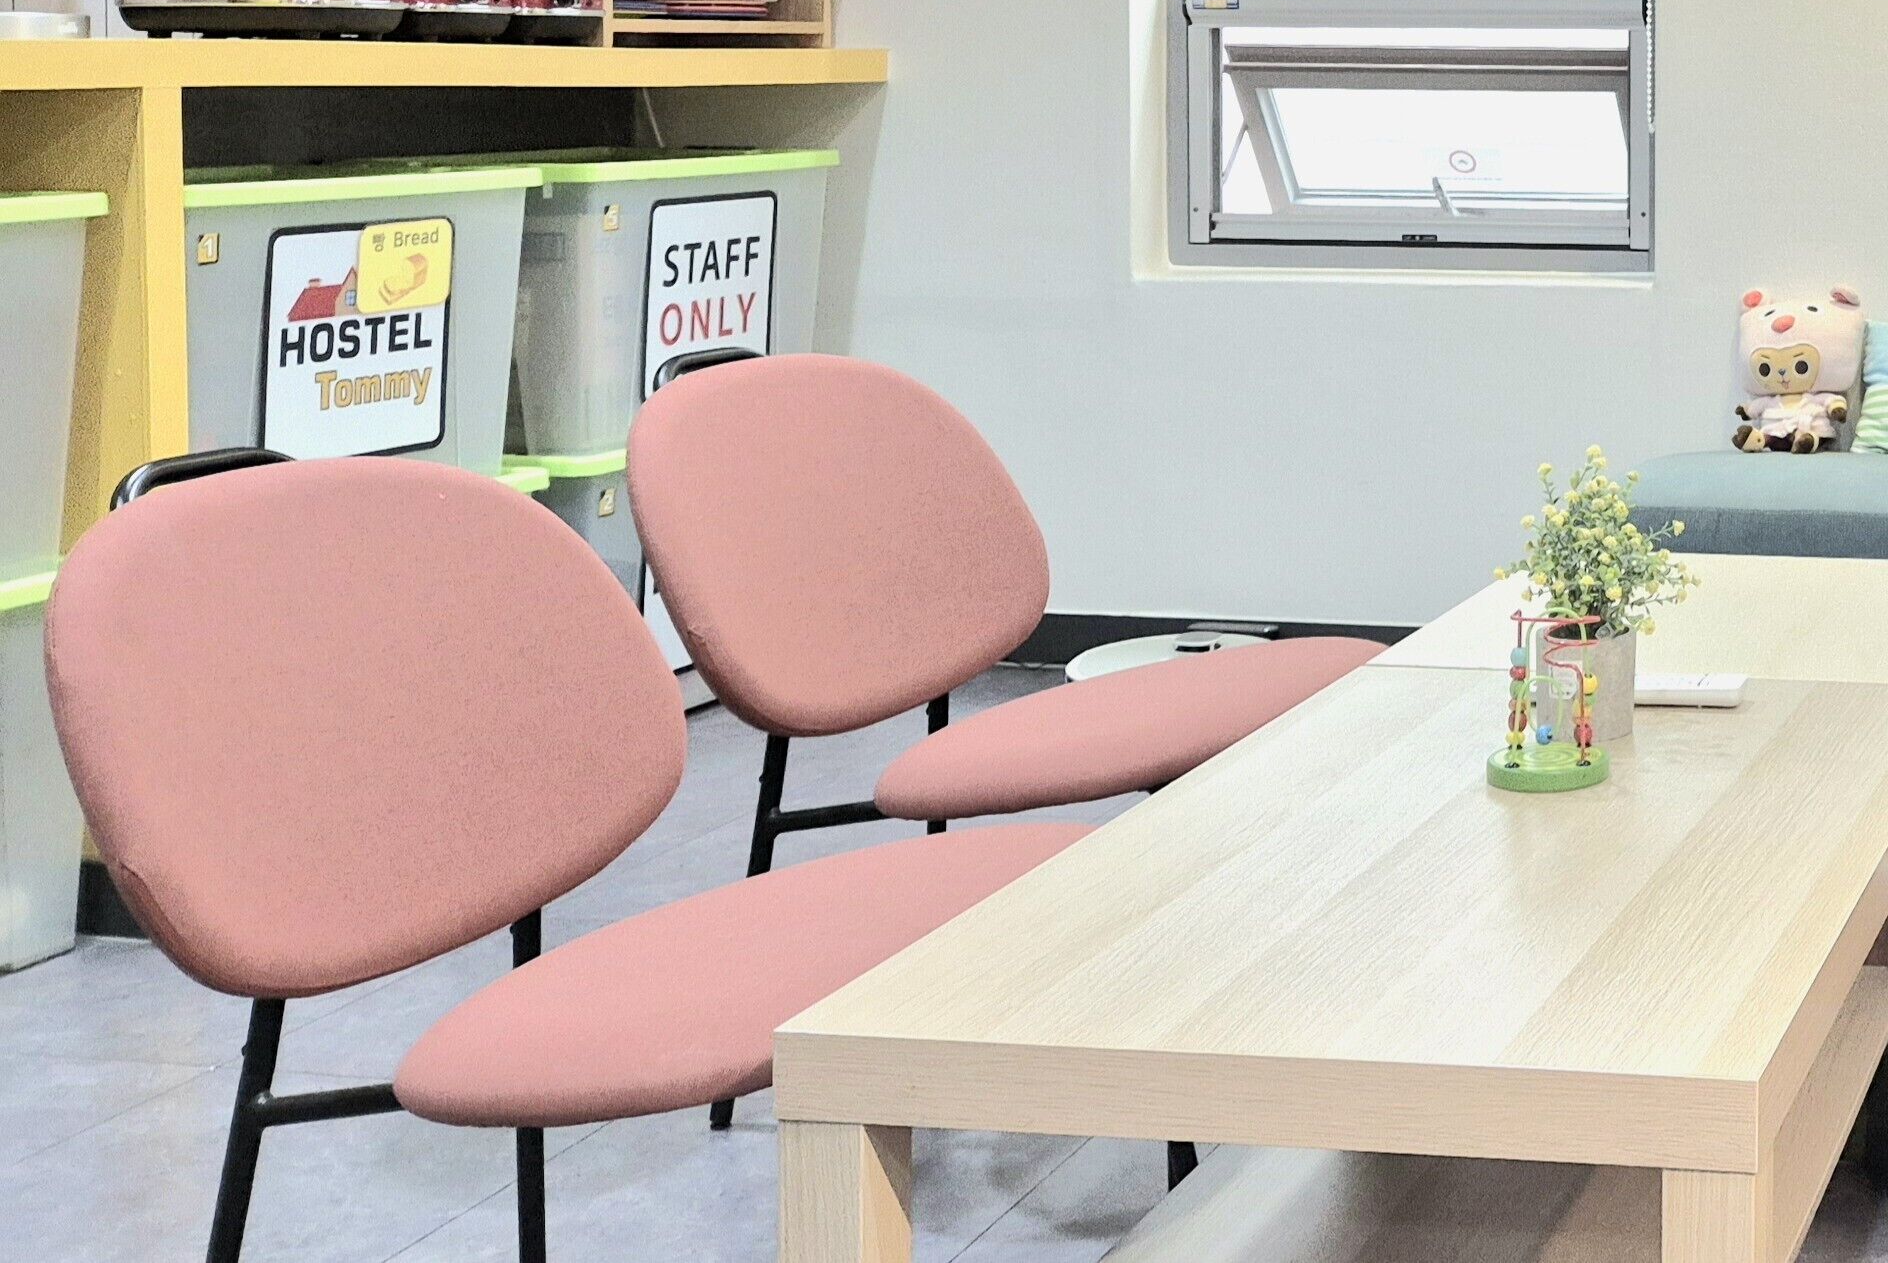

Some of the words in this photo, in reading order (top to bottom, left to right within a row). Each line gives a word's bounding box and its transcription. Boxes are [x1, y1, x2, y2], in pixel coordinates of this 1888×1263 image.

[393, 227, 440, 249] Bread
[662, 236, 761, 287] STAFF
[279, 312, 433, 368] HOSTEL
[660, 292, 757, 346] ONLY
[315, 366, 433, 411] Tommy
